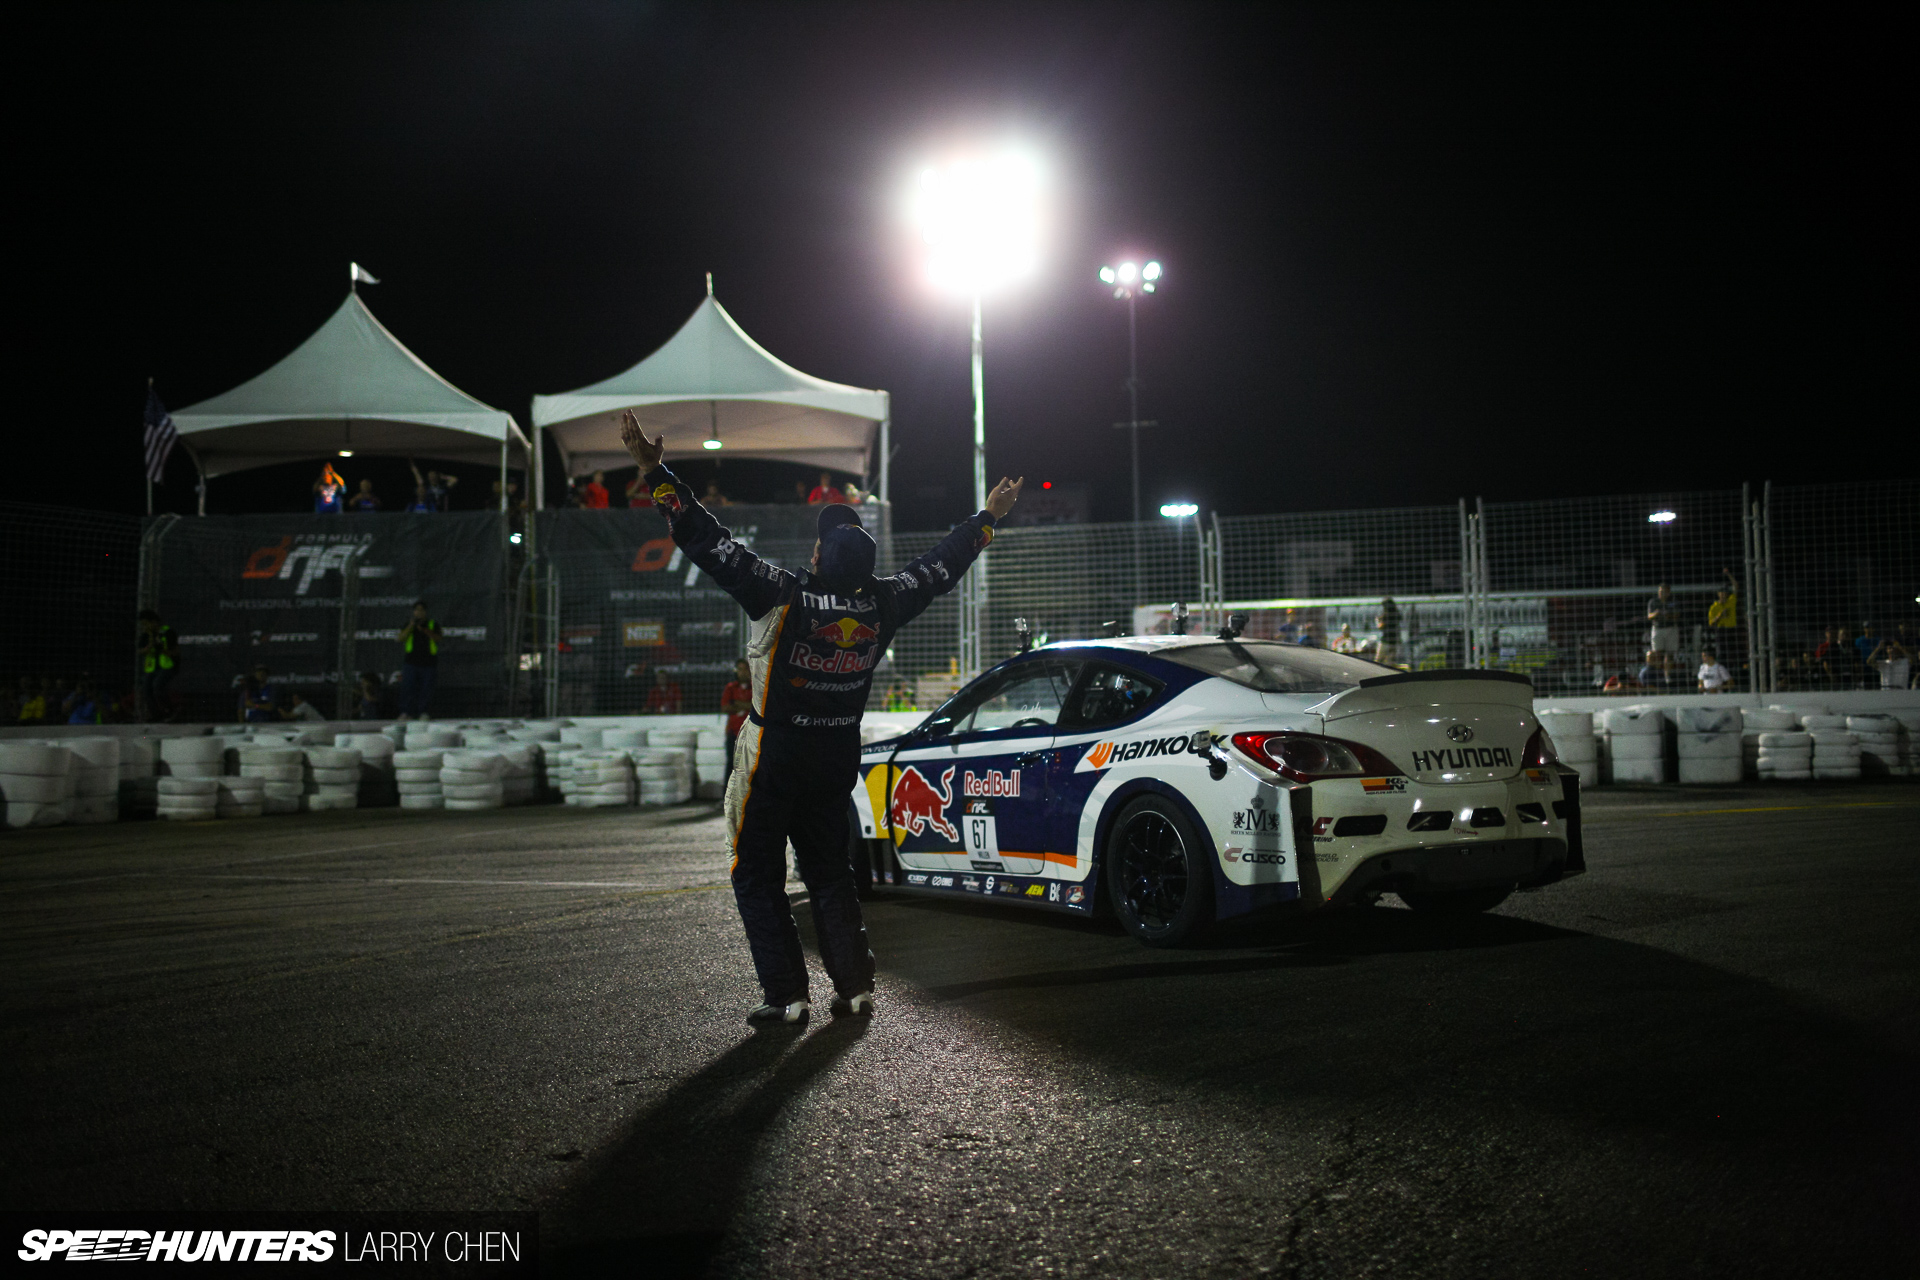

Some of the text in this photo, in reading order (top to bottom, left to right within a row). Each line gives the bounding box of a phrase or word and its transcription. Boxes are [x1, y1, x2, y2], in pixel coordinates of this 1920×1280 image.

[294, 533, 374, 545] FORMULA
[789, 642, 879, 673] Red Bull
[813, 715, 857, 726] HYUNDAI
[1412, 748, 1514, 772] HYUNDAI
[964, 770, 1021, 797] Red Bull
[972, 819, 987, 850] 67
[1242, 853, 1286, 865] CUSCO
